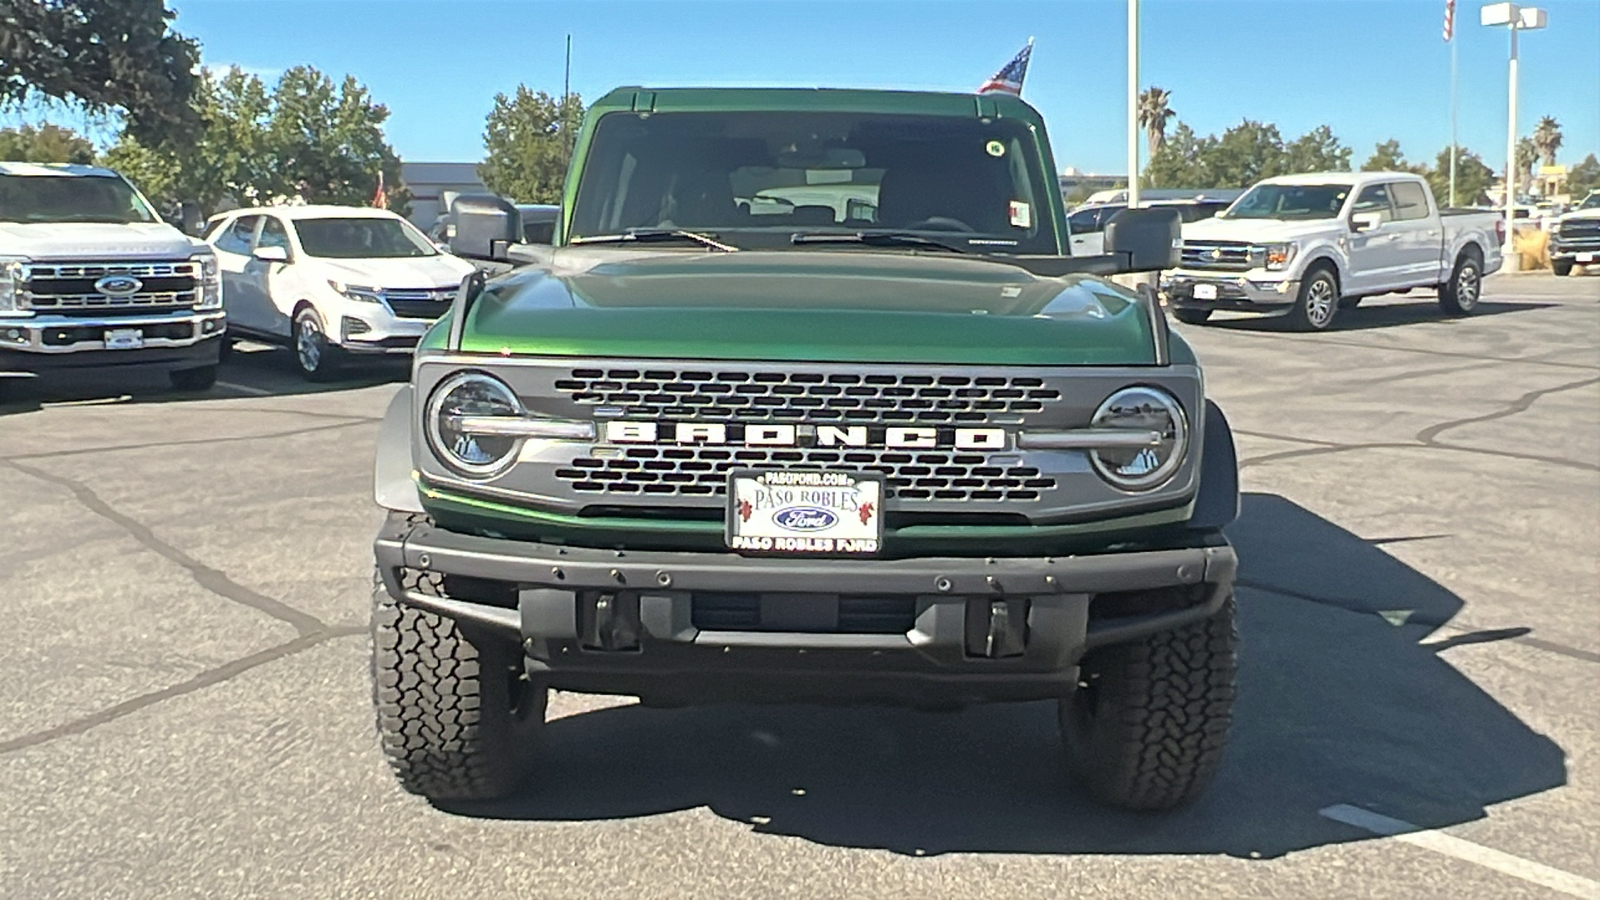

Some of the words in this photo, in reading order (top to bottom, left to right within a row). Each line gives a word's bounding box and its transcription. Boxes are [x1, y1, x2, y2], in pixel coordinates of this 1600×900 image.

[607, 421, 1005, 448] BRONCO
[765, 472, 848, 486] PASOFORD.COM
[755, 489, 794, 510] PASO
[800, 490, 859, 512] ROBLES
[784, 510, 828, 527] Ford
[732, 536, 773, 550] PASO
[775, 537, 834, 551] ROBLES
